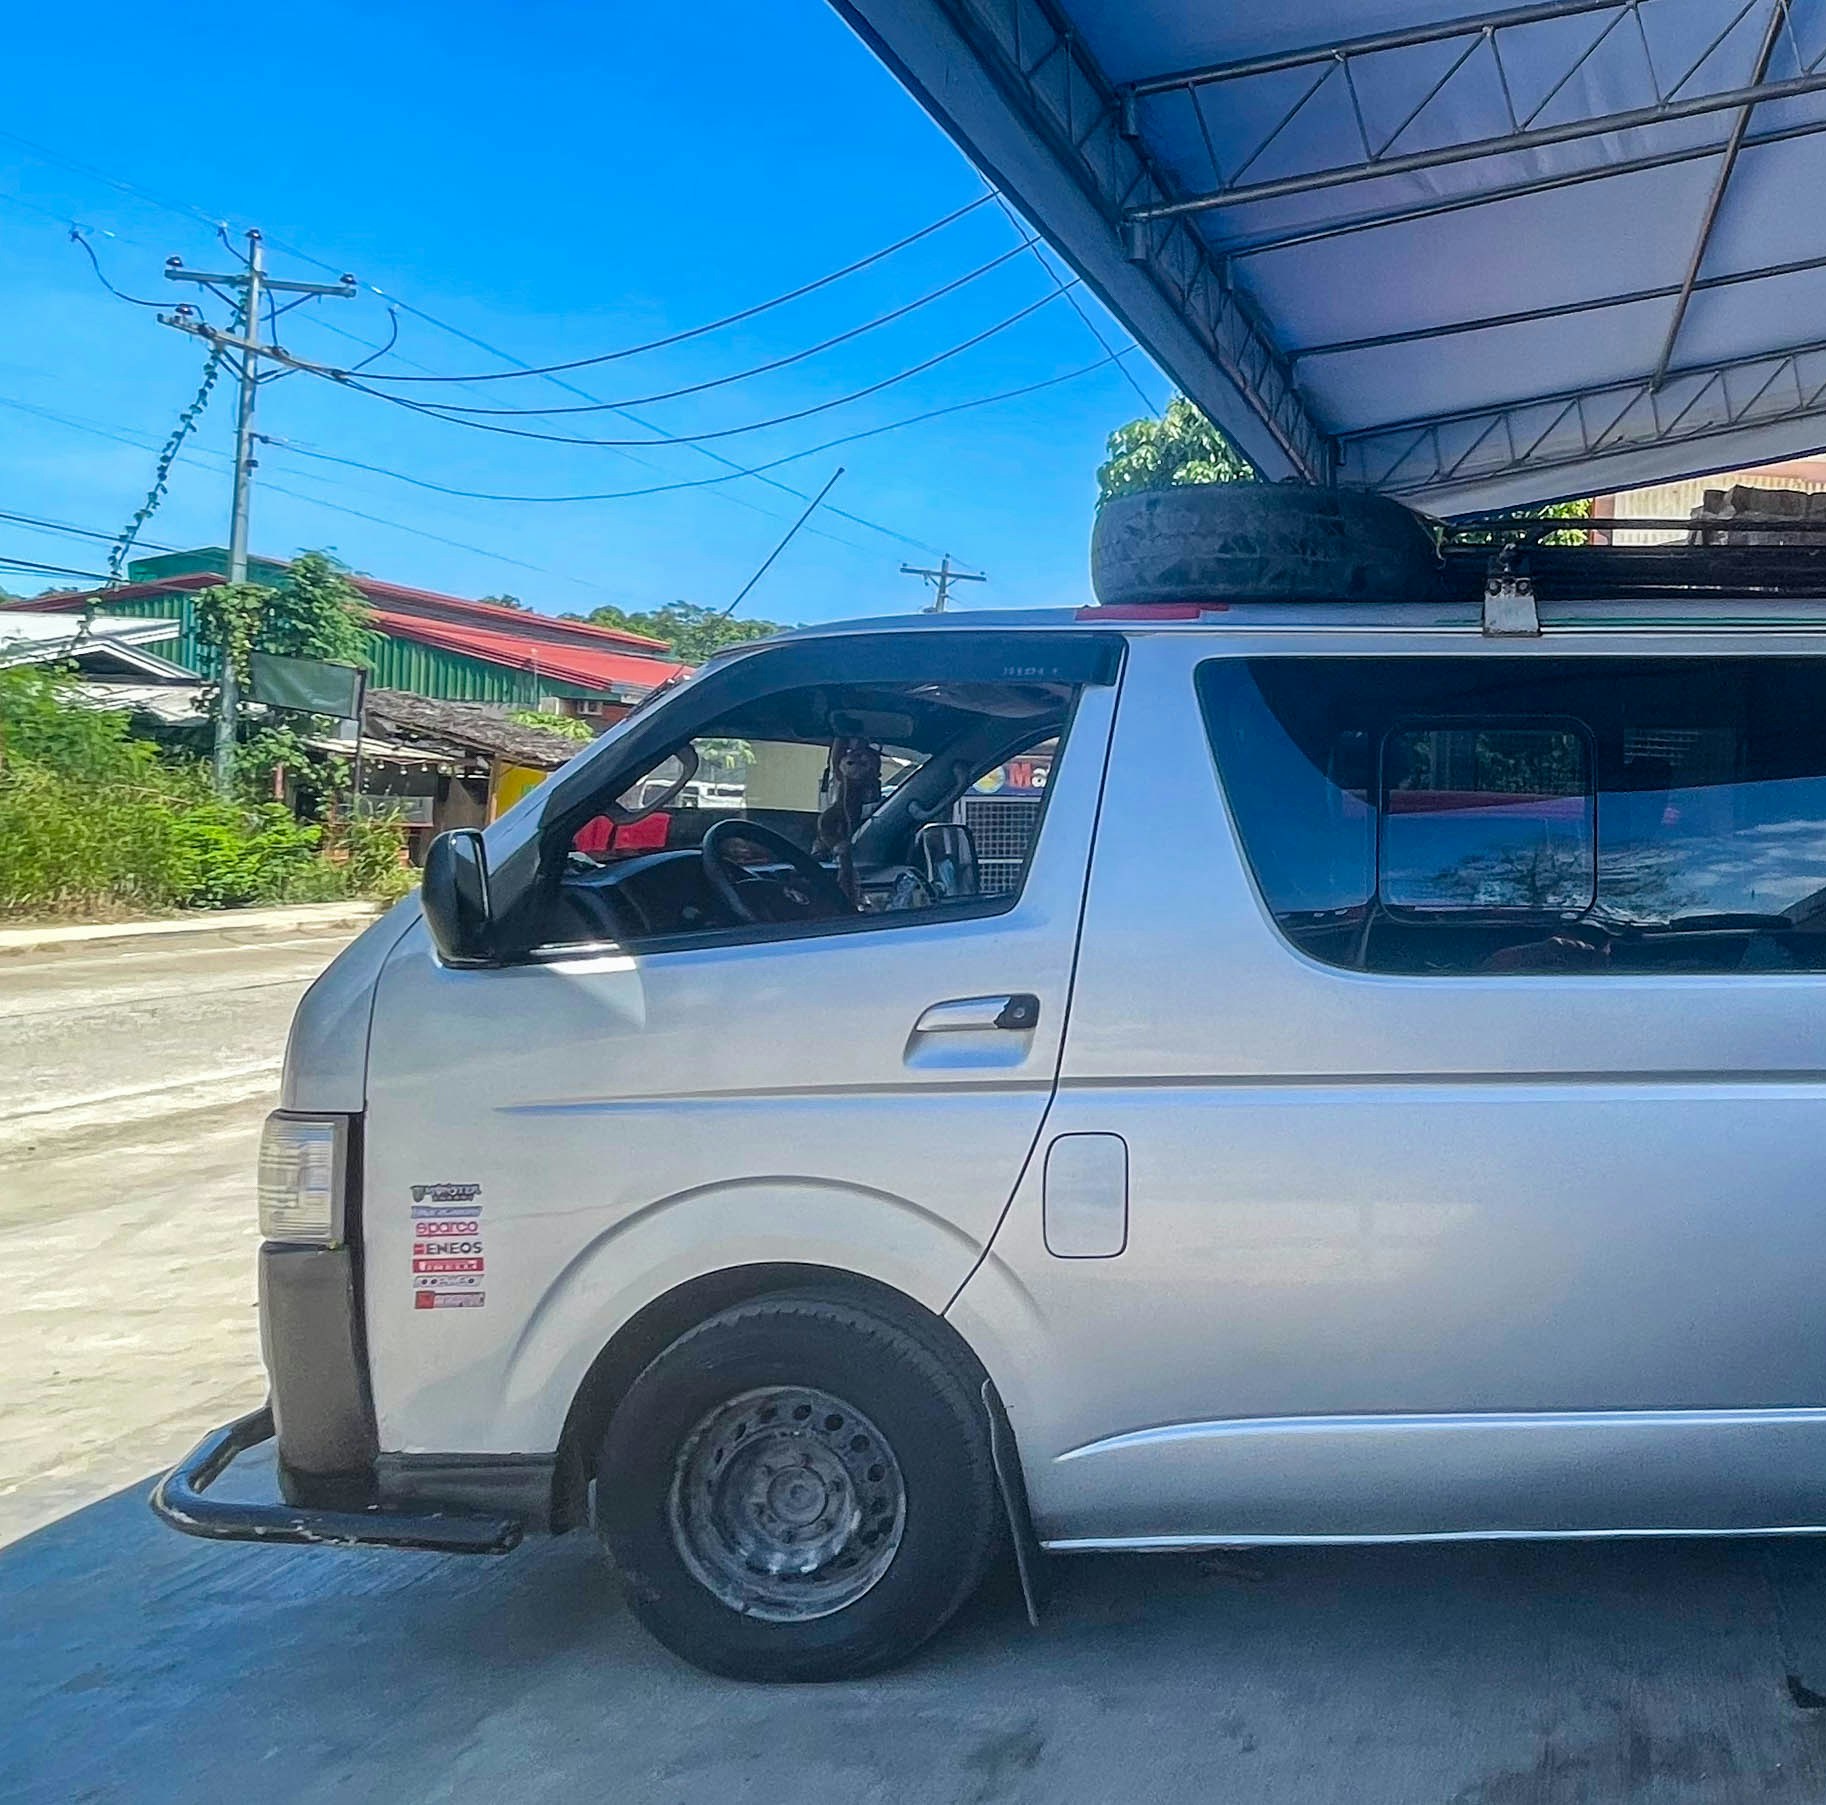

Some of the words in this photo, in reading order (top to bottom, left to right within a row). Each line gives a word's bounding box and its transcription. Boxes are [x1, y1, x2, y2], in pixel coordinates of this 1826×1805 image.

[1008, 761, 1050, 789] Ma
[416, 1221, 479, 1234] sparco
[426, 1242, 483, 1255] ENEOS
